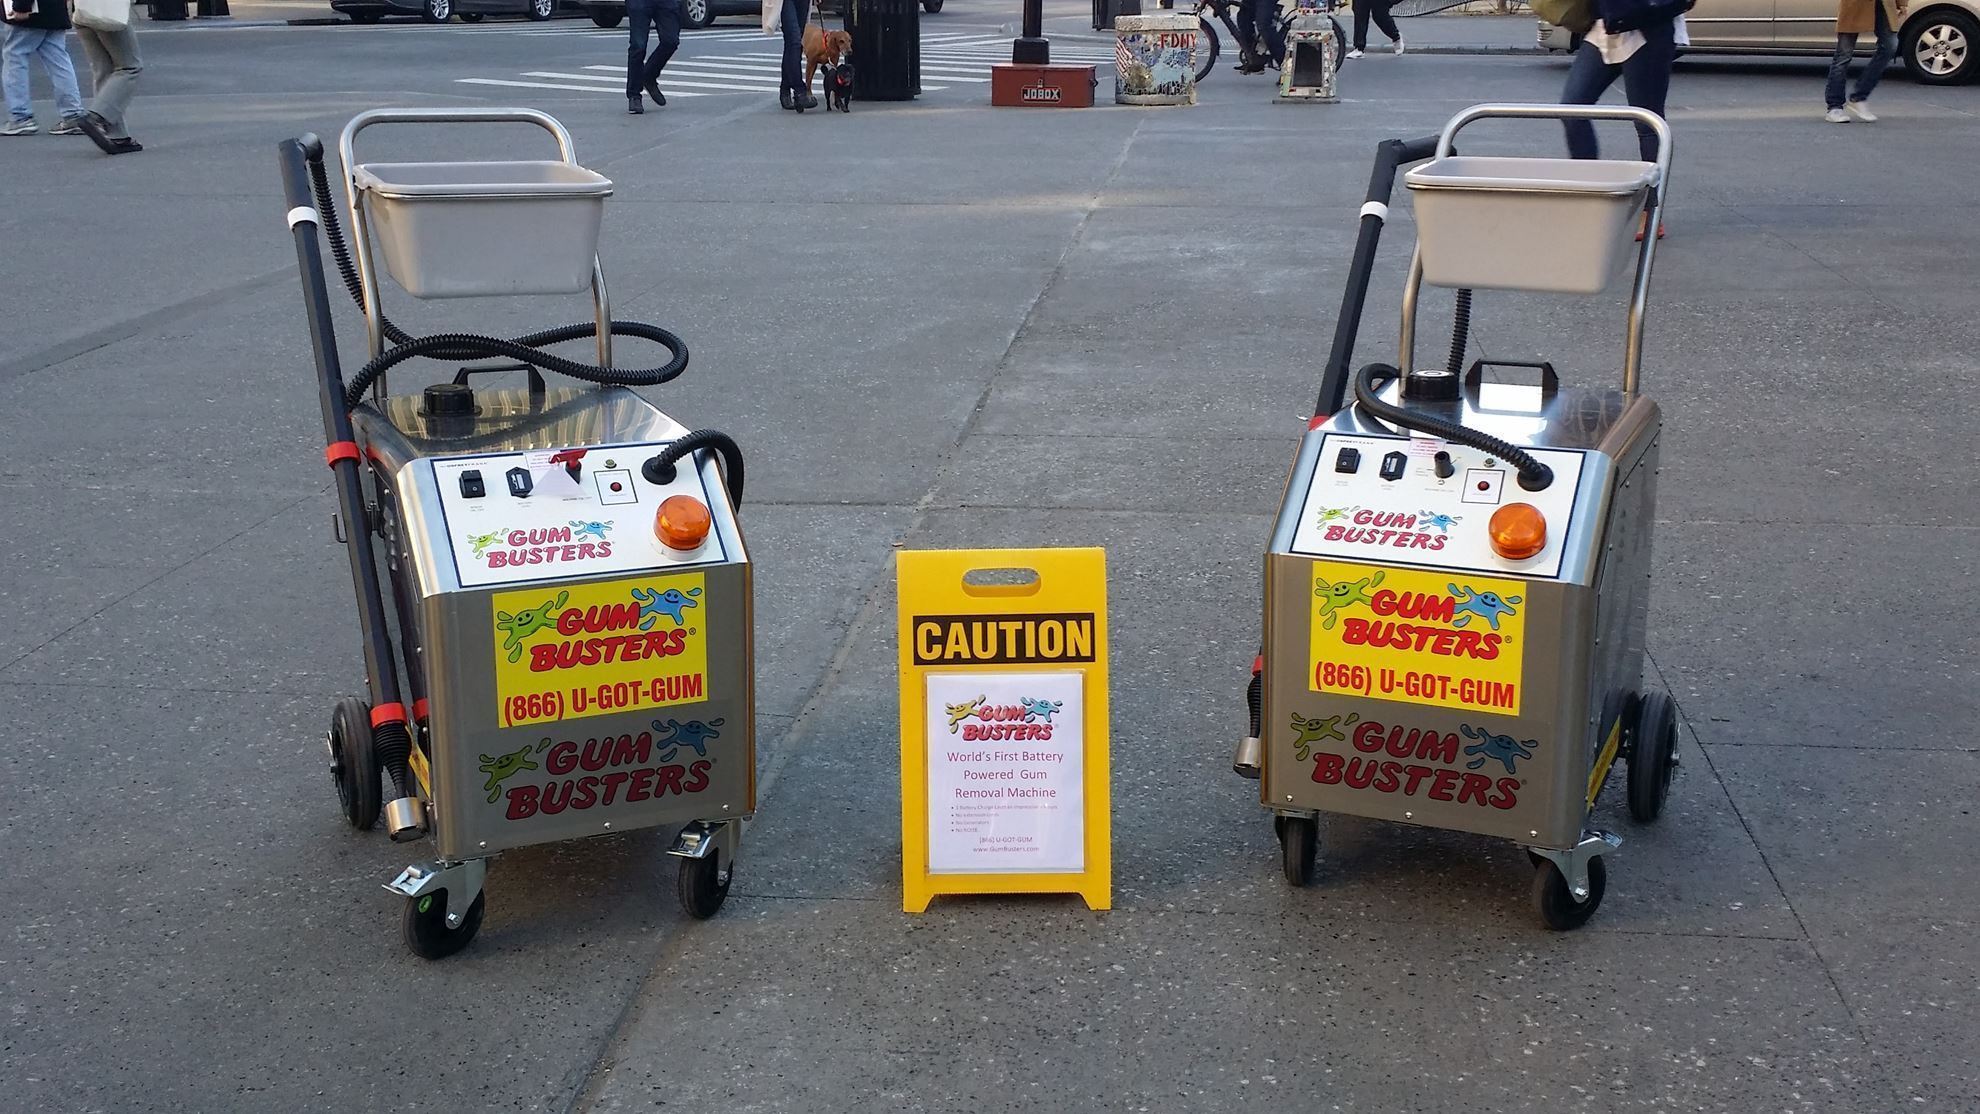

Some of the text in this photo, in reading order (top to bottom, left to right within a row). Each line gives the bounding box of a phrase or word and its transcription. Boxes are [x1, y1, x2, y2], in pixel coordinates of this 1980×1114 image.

[1159, 33, 1197, 49] FDNY
[1023, 88, 1060, 100] JOBOX
[1353, 509, 1417, 530] GUM
[508, 526, 571, 547] GUM
[1323, 525, 1448, 551] BUSTERS
[486, 541, 613, 569] BUSTERS
[556, 601, 641, 636] GUM
[1371, 589, 1455, 623] GUM
[916, 620, 1092, 661] CAUTION
[1315, 661, 1515, 709] (866) U-GOT-GUM
[504, 673, 703, 728] (866) U-GOT-GUM
[978, 705, 1027, 722] GUM
[962, 723, 1053, 741] BUSTERS
[1353, 721, 1460, 764] GUM
[546, 731, 652, 775] GUM
[947, 751, 1064, 764] World's First Battery
[963, 769, 1047, 780] Powered Gum
[1311, 752, 1521, 810] BUSTERS
[505, 760, 712, 821] BUSTERS
[955, 787, 1056, 798] Removal Machine
